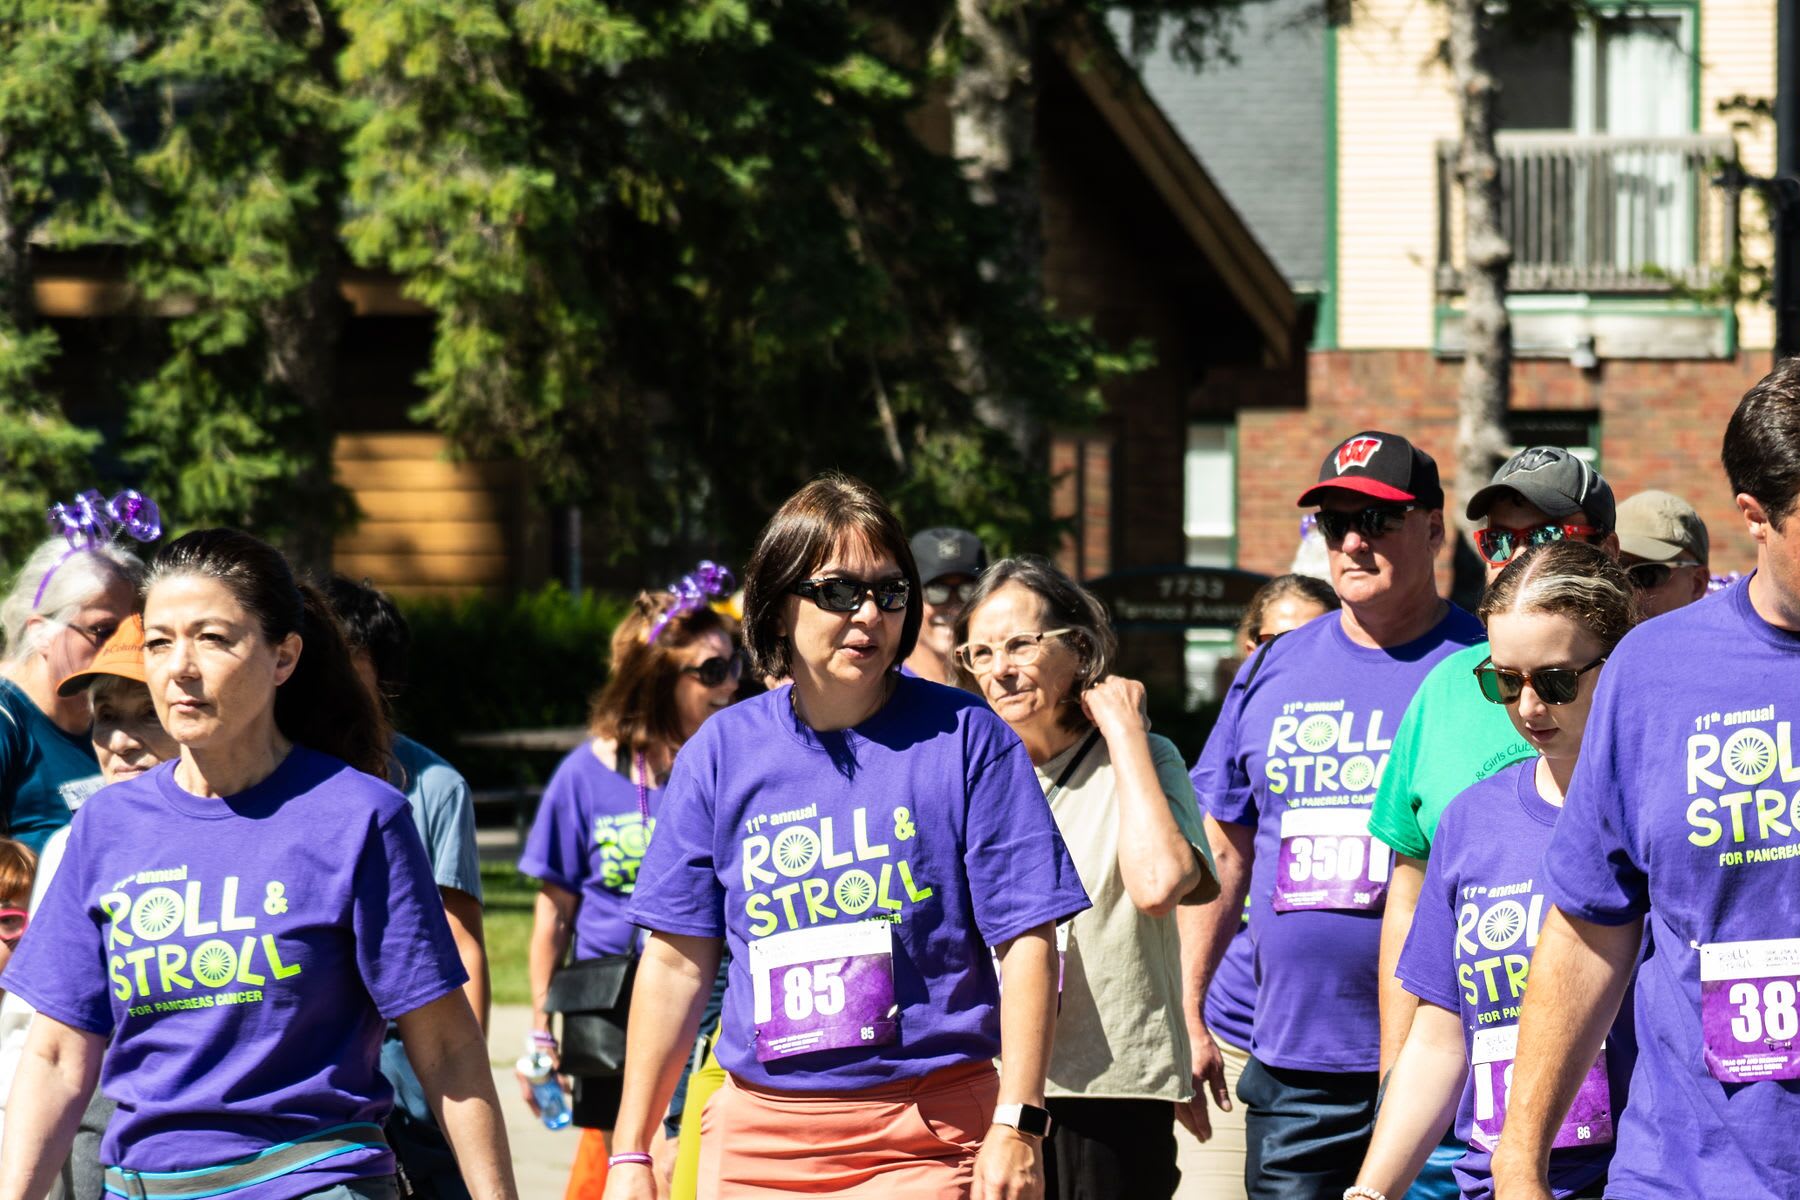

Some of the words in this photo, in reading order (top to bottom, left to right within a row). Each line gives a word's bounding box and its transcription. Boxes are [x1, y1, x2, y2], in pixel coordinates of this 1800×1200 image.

[1267, 710, 1392, 757] ROLL
[1723, 704, 1775, 726] annual
[1265, 753, 1390, 794] STROL
[1482, 751, 1506, 772] Girls
[770, 803, 817, 826] annual
[742, 807, 890, 891] ROLL
[893, 806, 916, 841] &
[1289, 837, 1365, 882] 350
[1719, 851, 1743, 867] FOR
[745, 860, 933, 937] STROLL
[1488, 879, 1533, 899] annual
[100, 876, 256, 951] ROLL
[263, 881, 288, 915] &
[1455, 894, 1544, 960] ROL
[109, 934, 302, 1001] STROLL
[1458, 954, 1530, 1007] STR
[128, 1006, 154, 1018] FOR
[154, 995, 214, 1013] PANCREAS
[215, 990, 263, 1006] CANCER
[783, 962, 846, 1021] 85
[860, 1026, 875, 1040] 85
[1477, 1010, 1501, 1025] FOR
[1577, 1126, 1591, 1140] 86
